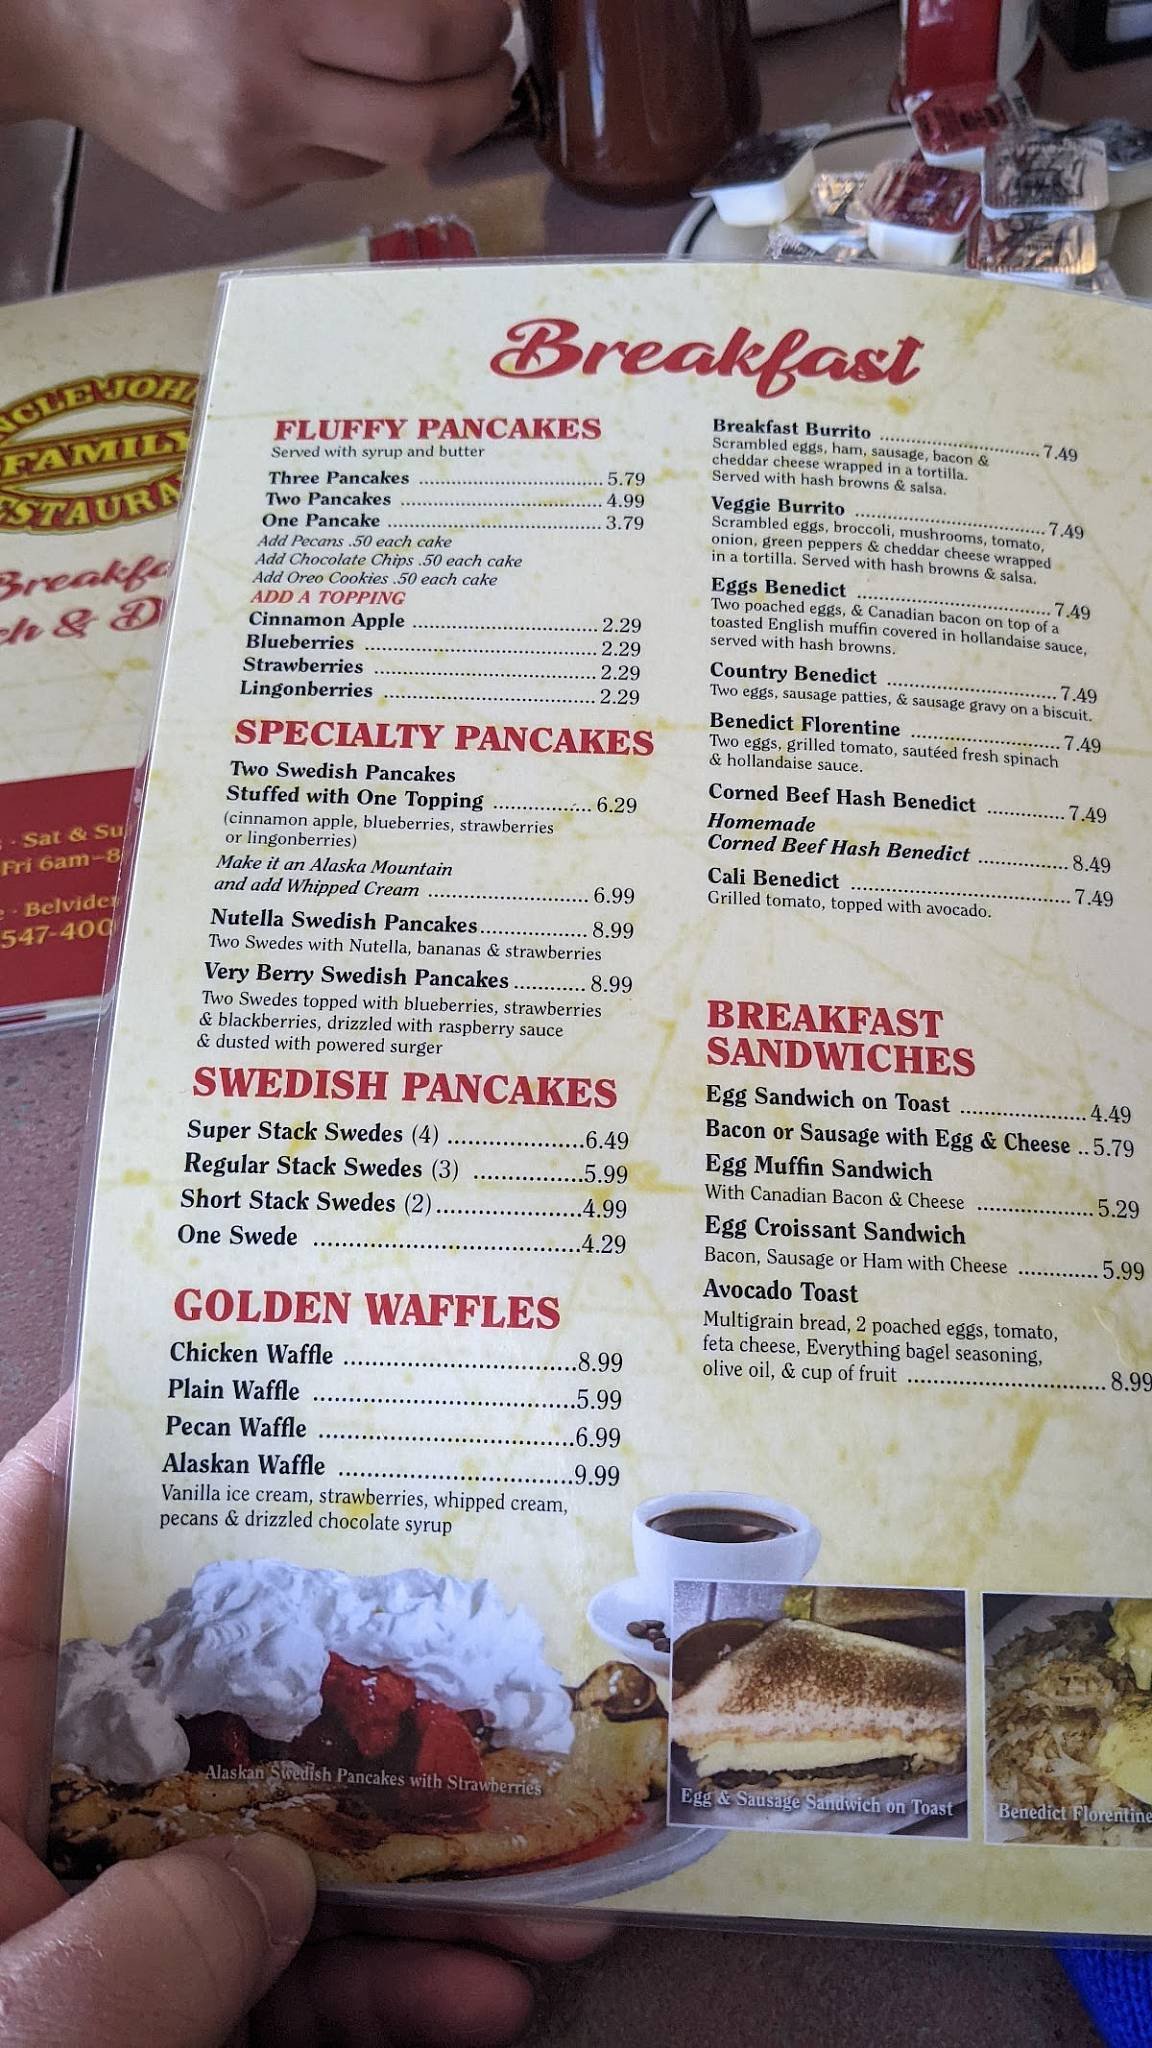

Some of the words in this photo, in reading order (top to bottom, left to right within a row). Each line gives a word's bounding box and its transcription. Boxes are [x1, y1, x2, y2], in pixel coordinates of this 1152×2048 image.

[490, 318, 924, 398] Breakfast
[274, 419, 407, 440] FLUFFY
[417, 418, 601, 439] PANCAKES
[714, 418, 798, 434] Breakfast
[806, 422, 870, 438] Burrito
[1043, 445, 1078, 462] 7.49
[271, 446, 319, 457] Served
[325, 445, 356, 456] with
[362, 449, 402, 459] syrup
[407, 445, 433, 456] and
[439, 445, 484, 456] butter
[268, 470, 319, 485] Three
[326, 470, 410, 485] Pancakes
[607, 472, 645, 486] 5.79
[265, 492, 301, 506] Two
[307, 492, 391, 506] Pancakes
[607, 494, 645, 508] 4.99
[262, 513, 299, 528] One
[305, 513, 380, 528] Pancake
[606, 516, 644, 530] 3.79
[711, 496, 770, 514] Veggie
[778, 498, 844, 515] Burrito
[1049, 523, 1084, 539] 7.49
[257, 534, 288, 546] Add
[291, 535, 343, 546] Pecans
[349, 535, 372, 546] .50
[376, 535, 411, 547] each
[417, 535, 451, 547] cake
[250, 590, 293, 603] ADD
[298, 590, 309, 603] A
[320, 591, 405, 604] TOPPING
[712, 577, 757, 595] Eggs
[765, 579, 845, 597] Benedict
[1054, 603, 1090, 620] 7.49
[249, 611, 344, 626] Cinnamon
[351, 612, 404, 630] Apple
[602, 617, 641, 633] 2.29
[246, 634, 354, 650] Blueberries
[602, 641, 640, 657] 2.29
[243, 657, 363, 673] Strawberries
[601, 665, 640, 681] 2.29
[710, 662, 787, 682] Country
[794, 665, 876, 684] Benedict
[1060, 686, 1097, 704] 7.49
[240, 680, 373, 699] Lingonberries
[600, 689, 639, 705] 2.29
[235, 719, 444, 748] SPECIALTY
[454, 725, 653, 755] PANCAKES
[710, 712, 793, 730] Benedict
[801, 716, 899, 736] Florentine
[1064, 736, 1101, 753] 7.49
[230, 760, 268, 776] Two
[276, 761, 357, 779] Swedish
[365, 764, 455, 782] Pancakes
[709, 753, 721, 765] &
[727, 753, 811, 769] hollandaise
[817, 761, 862, 772] sauce.
[226, 785, 299, 802] Stuffed
[306, 787, 348, 803] with
[357, 789, 396, 805] One
[404, 790, 483, 811] Topping
[597, 797, 637, 813] 6.29
[707, 813, 815, 832] Homemade
[23, 831, 61, 848] Sat
[68, 827, 87, 842] &
[225, 834, 242, 843] or
[247, 830, 356, 848] lingonberries)
[0, 858, 32, 877] Fri
[708, 867, 745, 884] Cali
[753, 869, 839, 888] Benedict
[1074, 890, 1113, 907] 7.49
[708, 890, 760, 905] Grilled
[766, 893, 824, 910] tomato,
[831, 897, 882, 913] topped
[887, 899, 921, 913] with
[926, 903, 991, 917] avocado.
[210, 908, 283, 926] Nutella
[291, 911, 375, 929] Swedish
[385, 914, 477, 934] Pancakes
[592, 922, 634, 939] 8.99
[204, 962, 249, 983] Very
[256, 963, 313, 985] Berry
[321, 965, 406, 984] Swedish
[414, 969, 508, 988] Pancakes
[591, 976, 632, 993] 8.99
[707, 1001, 943, 1038] BREAKFAST
[707, 1038, 975, 1076] SANDWICHES
[193, 1066, 389, 1101] SWEDISH
[402, 1072, 618, 1108] PANCAKES
[706, 1084, 747, 1107] Egg
[754, 1086, 854, 1108] Sandwich
[862, 1096, 887, 1109] on
[894, 1093, 950, 1112] Toast
[1091, 1105, 1131, 1123] 4.49
[187, 1119, 251, 1142] Super
[258, 1120, 317, 1140] Stack
[324, 1122, 402, 1142] Swedes
[412, 1124, 438, 1146] (4)
[585, 1131, 628, 1150] 6.49
[184, 1152, 269, 1177] Regular
[277, 1155, 336, 1175] Stack
[344, 1157, 421, 1177] Swedes
[432, 1159, 458, 1182] (3)
[584, 1164, 627, 1184] 5.99
[706, 1153, 747, 1177] Egg
[754, 1155, 823, 1176] Muffin
[832, 1158, 932, 1181] Sandwich
[178, 1225, 221, 1244] One
[229, 1226, 297, 1246] Swede
[581, 1234, 626, 1254] 4.29
[702, 1278, 791, 1300] Avocado
[800, 1282, 858, 1303] Toast
[174, 1289, 350, 1324] GOLDEN
[365, 1293, 560, 1330] WAFFLES
[170, 1340, 257, 1362] Chicken
[266, 1343, 332, 1364] Waffle
[578, 1352, 623, 1372] 8.99
[703, 1334, 733, 1351] feta
[740, 1335, 799, 1356] cheese,
[807, 1338, 900, 1361] Everything
[906, 1341, 949, 1362] bagel
[955, 1344, 1042, 1367] seasoning,
[168, 1377, 223, 1398] Plain
[232, 1379, 299, 1400] Waffle
[577, 1389, 621, 1409] 5.99
[165, 1415, 230, 1436] Pecan
[239, 1416, 306, 1437] Waffle
[575, 1427, 620, 1448] 6.99
[161, 1451, 249, 1473] Alaskan
[258, 1453, 324, 1475] Waffle
[574, 1465, 620, 1486] 9.99
[206, 1765, 264, 1780] Alaskan
[271, 1766, 331, 1782] Swedish
[337, 1768, 405, 1787] Pancakes
[410, 1773, 442, 1789] with
[449, 1775, 542, 1796] Strawberries
[681, 1788, 711, 1807] Egg
[717, 1790, 731, 1806] &
[736, 1791, 800, 1811] Sausage
[806, 1795, 880, 1813] Sandwich
[886, 1801, 905, 1814] on
[911, 1800, 954, 1816] Toast
[1000, 1803, 1067, 1821] Benedict
[1072, 1805, 1152, 1824] Florentine
